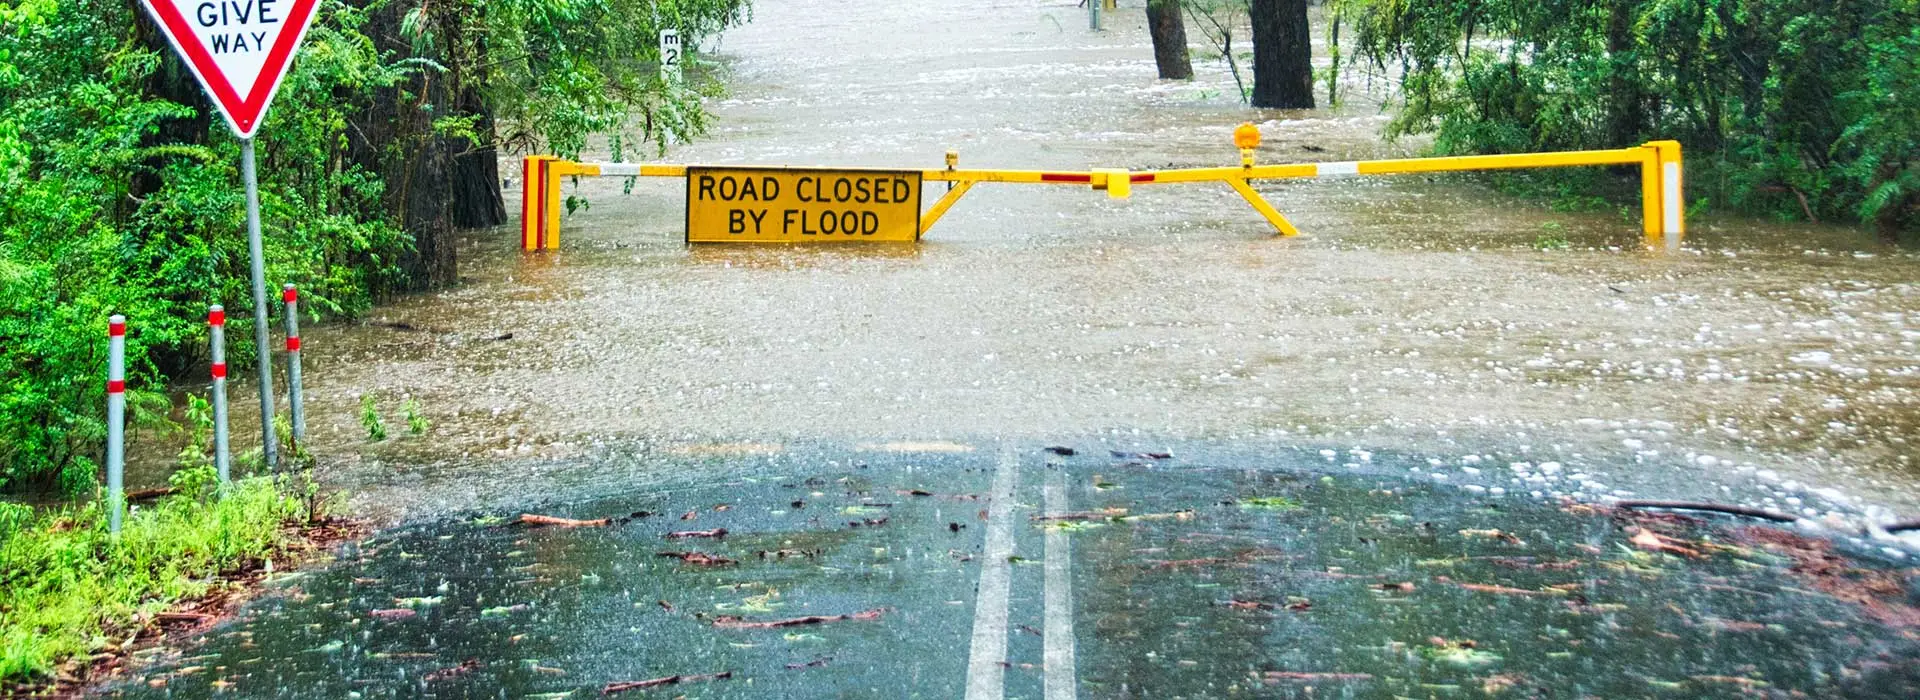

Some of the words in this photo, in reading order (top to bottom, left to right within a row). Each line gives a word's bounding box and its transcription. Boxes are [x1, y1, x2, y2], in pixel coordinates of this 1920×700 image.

[197, 0, 278, 27] GIVE
[211, 31, 266, 54] WAY
[664, 34, 678, 44] m
[666, 48, 678, 65] 2
[698, 175, 780, 201] ROAD
[796, 176, 910, 203] CLOSED
[728, 208, 768, 234] BY
[783, 209, 879, 235] FLOOD
